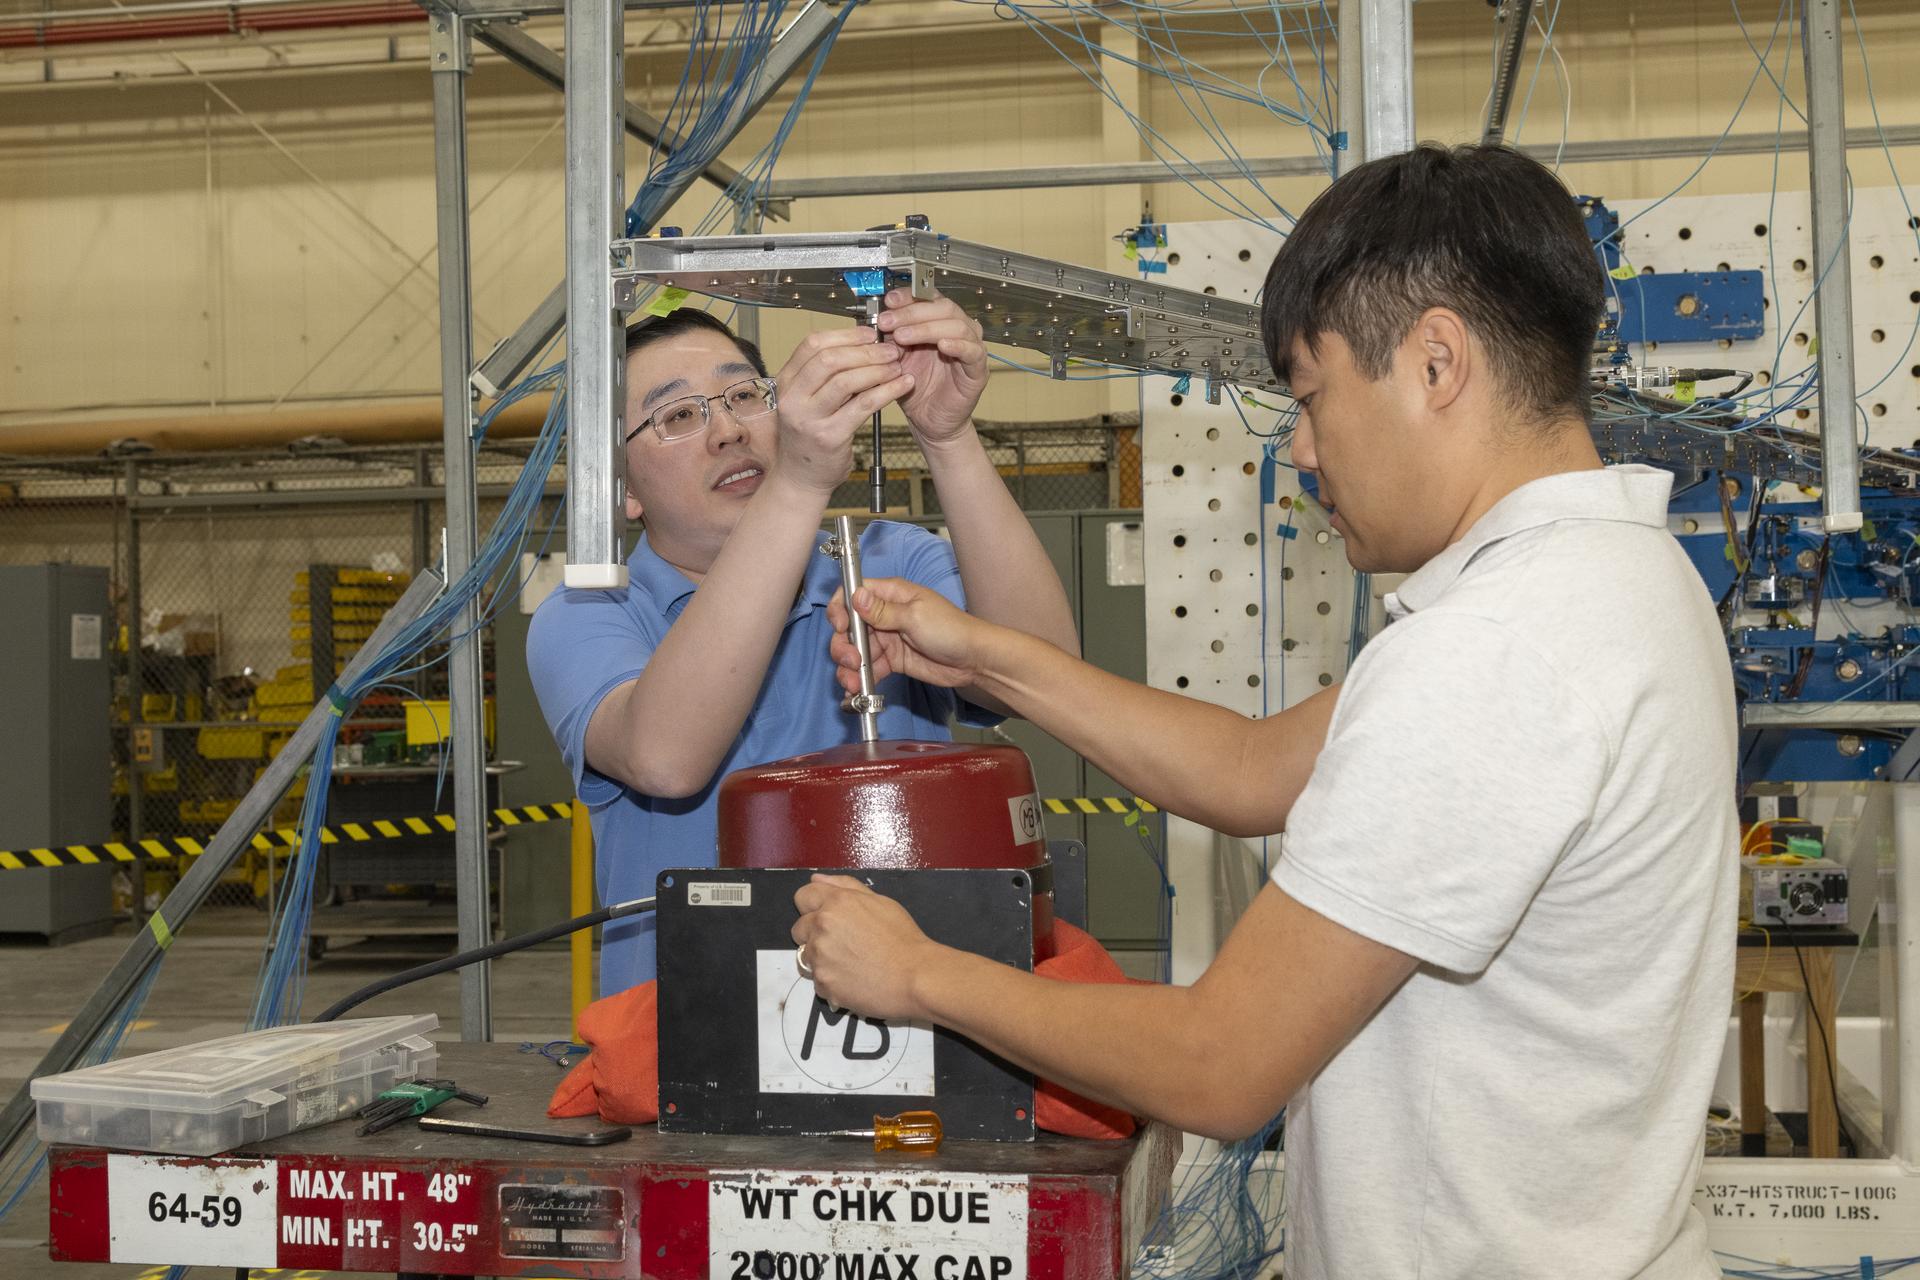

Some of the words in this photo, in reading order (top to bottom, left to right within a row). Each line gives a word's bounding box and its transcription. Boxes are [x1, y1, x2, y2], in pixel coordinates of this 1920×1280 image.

[289, 1169, 354, 1200] MAX.
[362, 1171, 405, 1201] HT.
[427, 1172, 472, 1203] 48"
[148, 1191, 242, 1228] 64-59
[739, 1188, 798, 1220] WT
[812, 1189, 897, 1222] CHK
[910, 1190, 990, 1224] DUE
[1769, 1204, 1825, 1219] 7,000
[1836, 1205, 1879, 1220] LBS.
[282, 1215, 339, 1247] MIN.
[347, 1218, 390, 1249] HT.
[412, 1221, 479, 1253] 30.5"
[835, 1253, 920, 1280] MAX
[934, 1254, 1013, 1280] CAP
